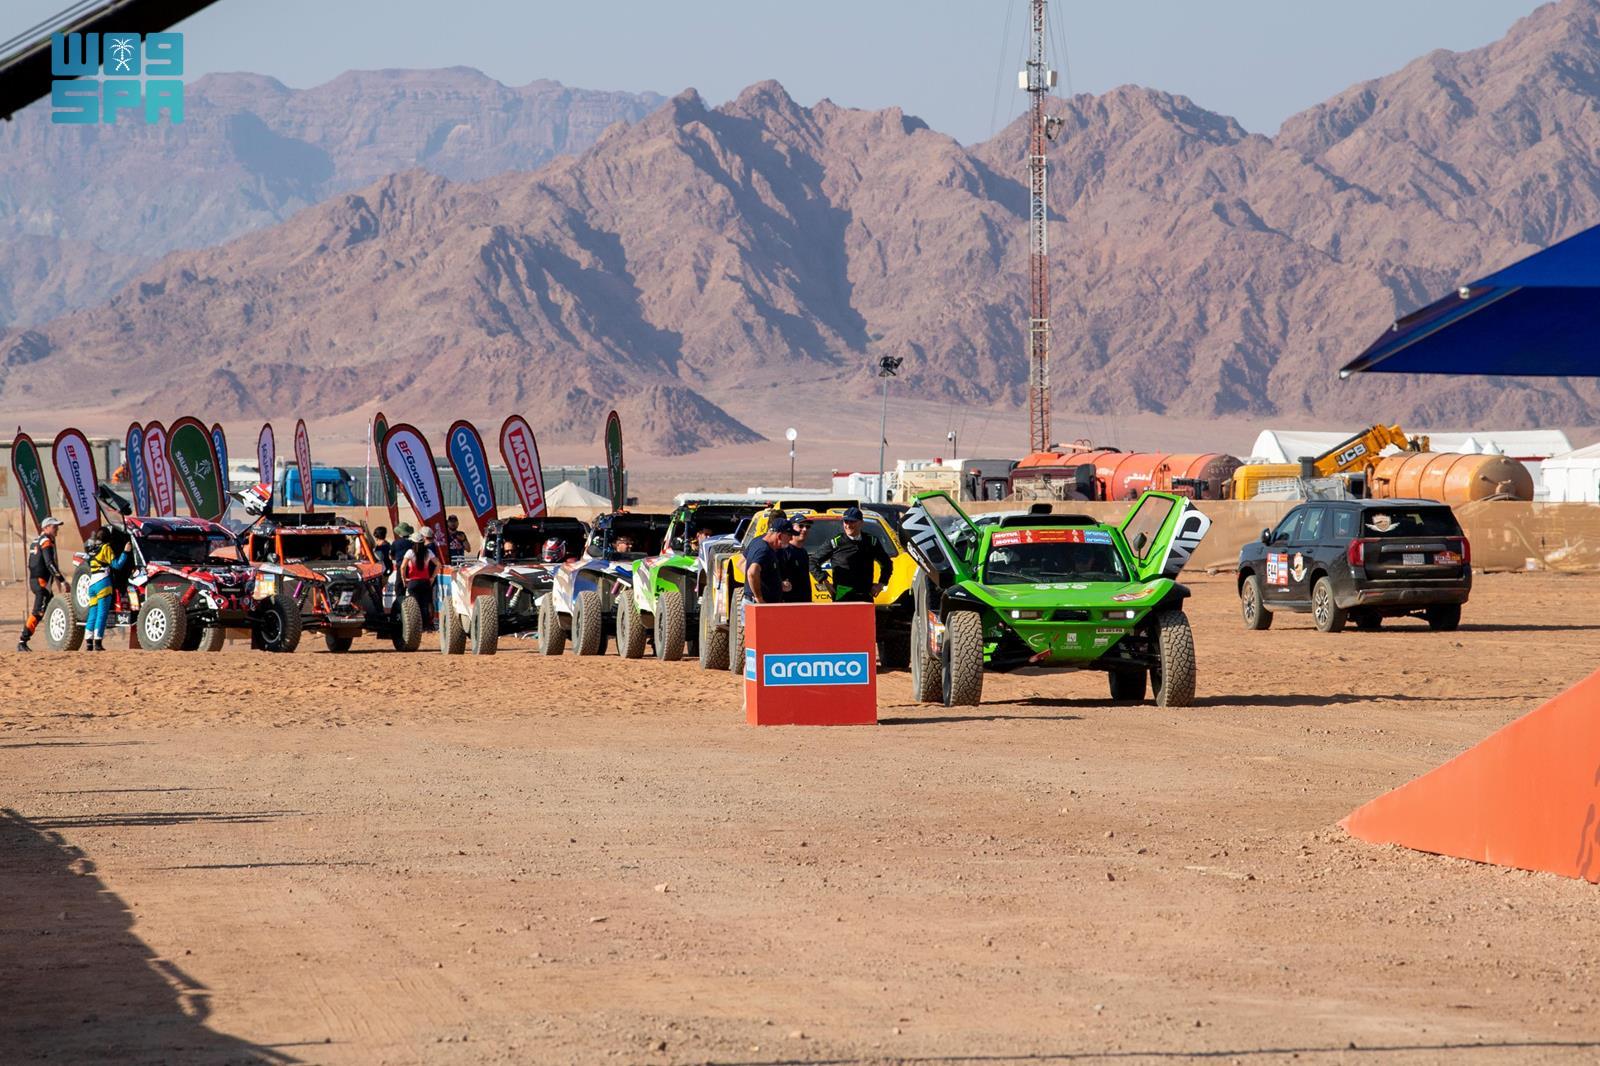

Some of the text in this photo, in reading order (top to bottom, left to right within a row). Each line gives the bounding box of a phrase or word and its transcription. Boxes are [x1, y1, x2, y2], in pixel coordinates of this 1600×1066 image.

[66, 444, 91, 515] BFGoodrich
[131, 433, 147, 511] aramco
[149, 439, 170, 512] MOTUL
[175, 450, 190, 476] SAUDI
[187, 475, 204, 507] ARABIA
[397, 440, 432, 508] BFGoodrich
[457, 432, 487, 507] aramco
[511, 435, 539, 507] MOTUL
[1336, 443, 1367, 466] JCB
[770, 660, 862, 678] aramco
